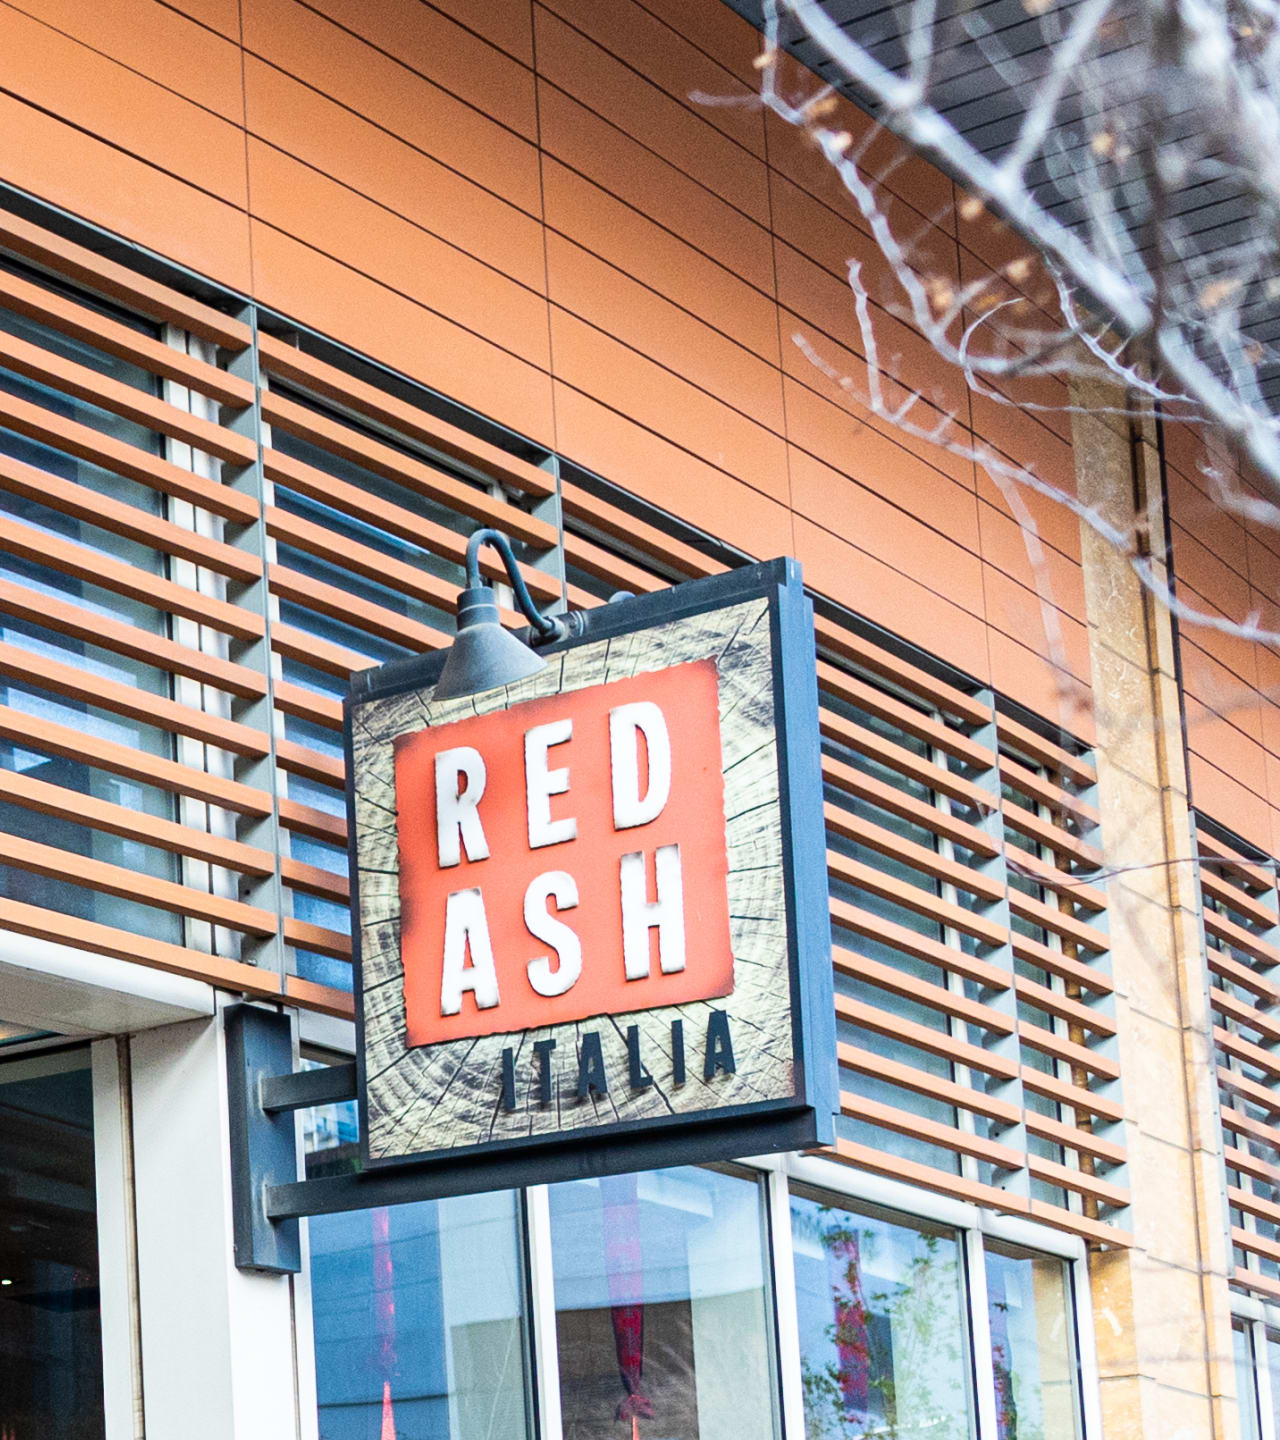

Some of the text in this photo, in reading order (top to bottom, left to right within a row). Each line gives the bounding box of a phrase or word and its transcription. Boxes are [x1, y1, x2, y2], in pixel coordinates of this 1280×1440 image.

[434, 700, 672, 869] RED
[439, 843, 687, 1017] ASH
[502, 1010, 737, 1110] ITALIA
